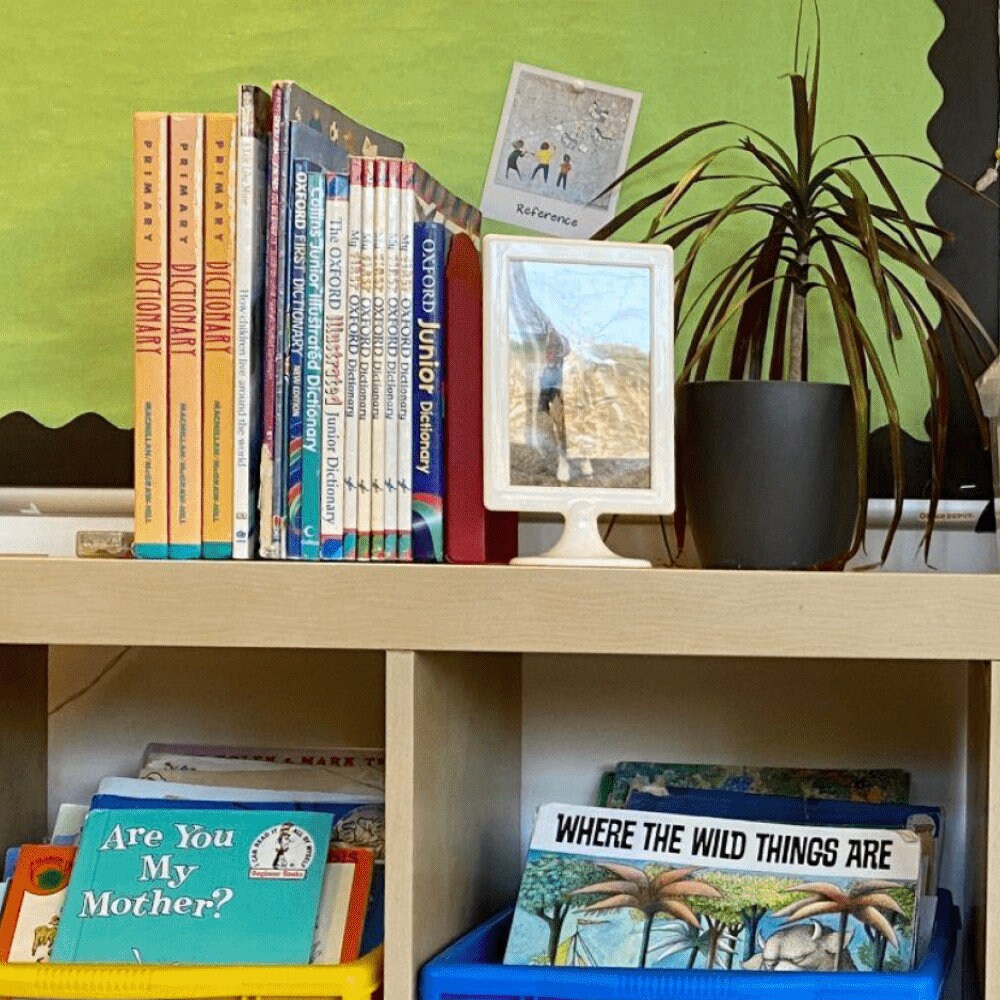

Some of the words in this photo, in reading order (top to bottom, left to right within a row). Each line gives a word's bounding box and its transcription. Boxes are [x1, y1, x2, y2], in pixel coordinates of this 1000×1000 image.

[143, 140, 153, 242] PRIMARY
[179, 143, 188, 244] PRIMARY
[214, 140, 224, 242] PRIMARY
[294, 171, 308, 229] OXFORD
[310, 187, 324, 237] Collins
[516, 203, 578, 228] Reference
[293, 233, 307, 271] FIRST
[329, 219, 342, 243] The
[309, 242, 324, 289] Junior
[328, 247, 342, 310] OXFORD
[421, 238, 436, 313] OXFORD
[135, 262, 162, 355] DICTIONARY
[170, 264, 197, 356] DICTIONARY
[205, 262, 232, 355] DICTIONARY
[291, 278, 306, 359] DICTIONARY
[306, 293, 322, 370] Illustrated
[348, 295, 360, 355] OXFORD
[360, 297, 371, 357] OXFORD
[373, 296, 385, 357] OXFORD
[387, 297, 398, 357] OXFORD
[400, 298, 411, 358] OXFORD
[417, 318, 441, 394] Junior
[303, 374, 321, 452] Dictionary
[346, 358, 359, 418] Dictionary
[359, 361, 371, 420] Dictionary
[372, 361, 384, 420] Dictionary
[385, 361, 397, 420] Dictionary
[398, 362, 410, 420] Dictionary
[326, 411, 340, 452] Junior
[415, 401, 434, 474] Dictionary
[321, 457, 340, 524] Dictionary
[99, 823, 164, 851] Are
[174, 823, 235, 850] You
[555, 812, 638, 850] WHERE
[641, 821, 685, 855] THE
[690, 826, 747, 861] WILD
[755, 831, 839, 867] THINGS
[844, 838, 894, 871] ARE
[137, 854, 200, 889] My
[77, 887, 234, 919] Mother?
